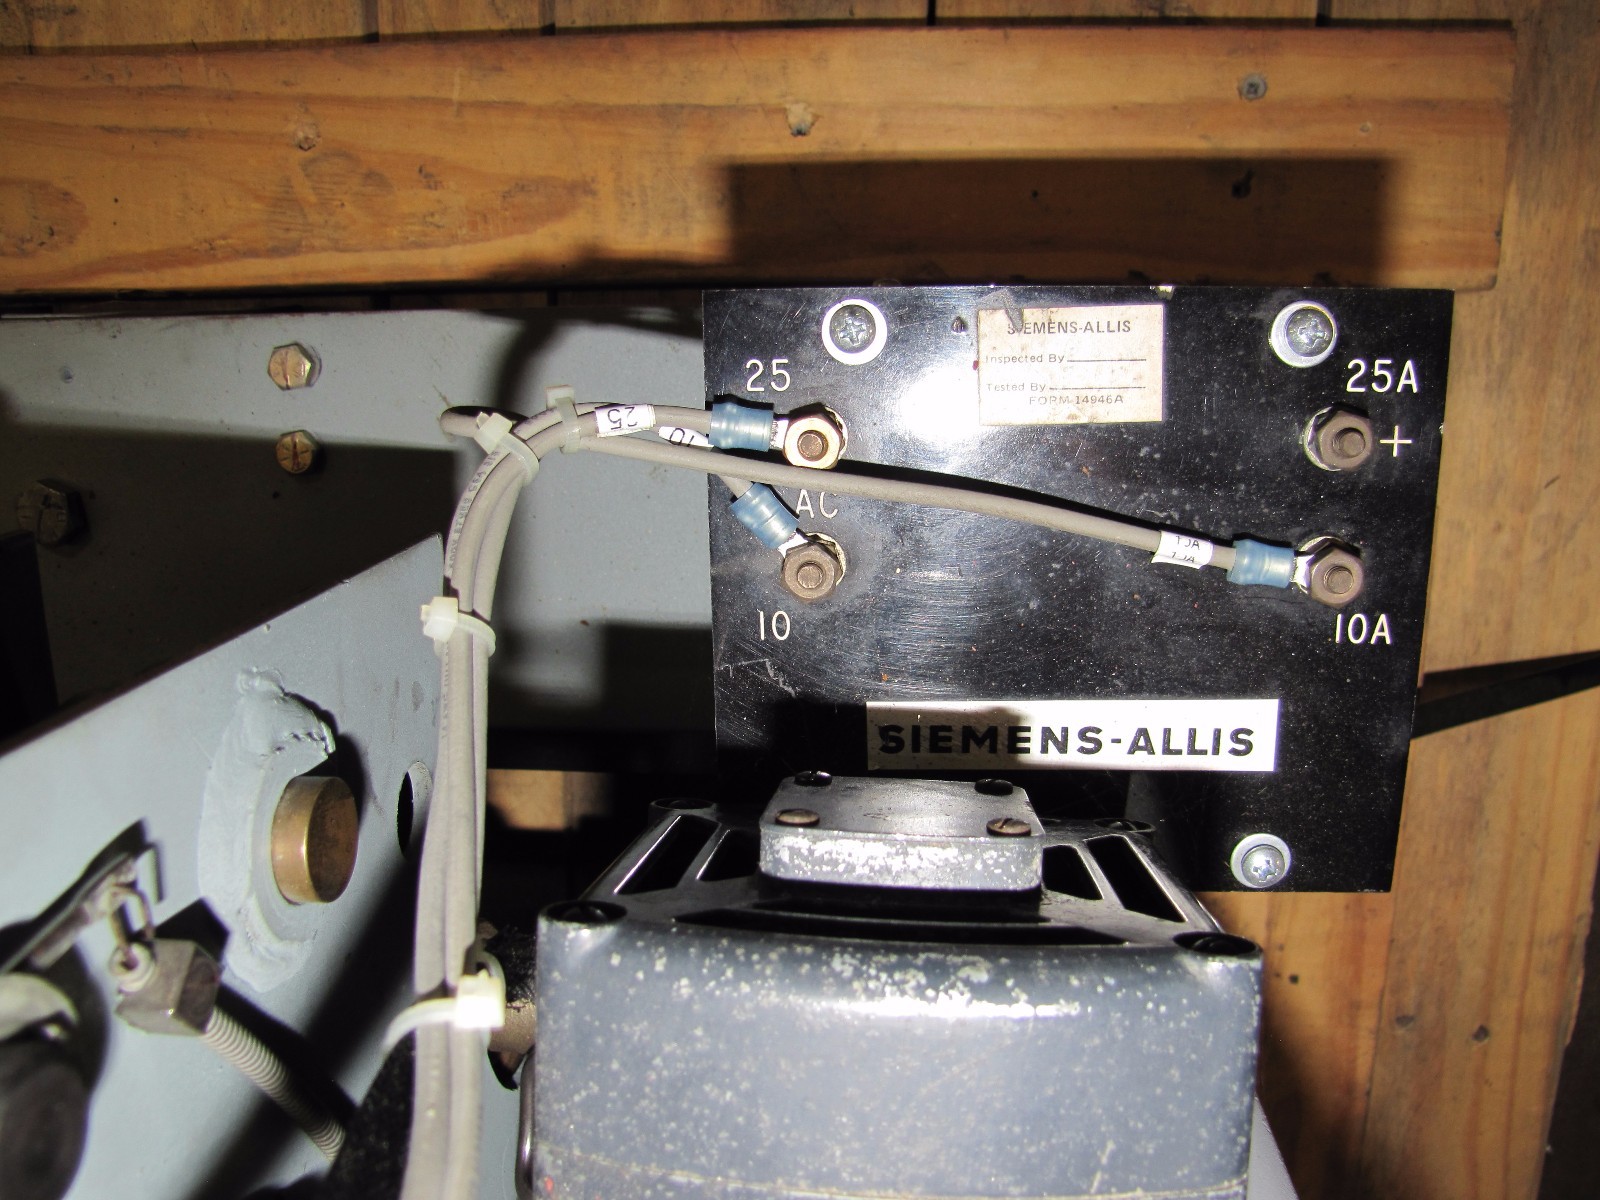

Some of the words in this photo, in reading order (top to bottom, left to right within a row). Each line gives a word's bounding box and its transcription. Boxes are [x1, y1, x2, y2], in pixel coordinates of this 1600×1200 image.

[1007, 320, 1131, 335] SEMENS-ALLIS
[985, 354, 1043, 365] Inspected
[1048, 354, 1065, 364] By
[745, 358, 792, 393] 25
[987, 383, 1025, 392] Tested
[1030, 383, 1046, 393] By
[1345, 359, 1419, 394] 25A
[607, 406, 638, 430] 25
[795, 489, 839, 519] AC
[758, 609, 792, 641] 10
[1334, 613, 1393, 645] 10A
[878, 724, 1254, 757] SIEMENS-ALLIS
